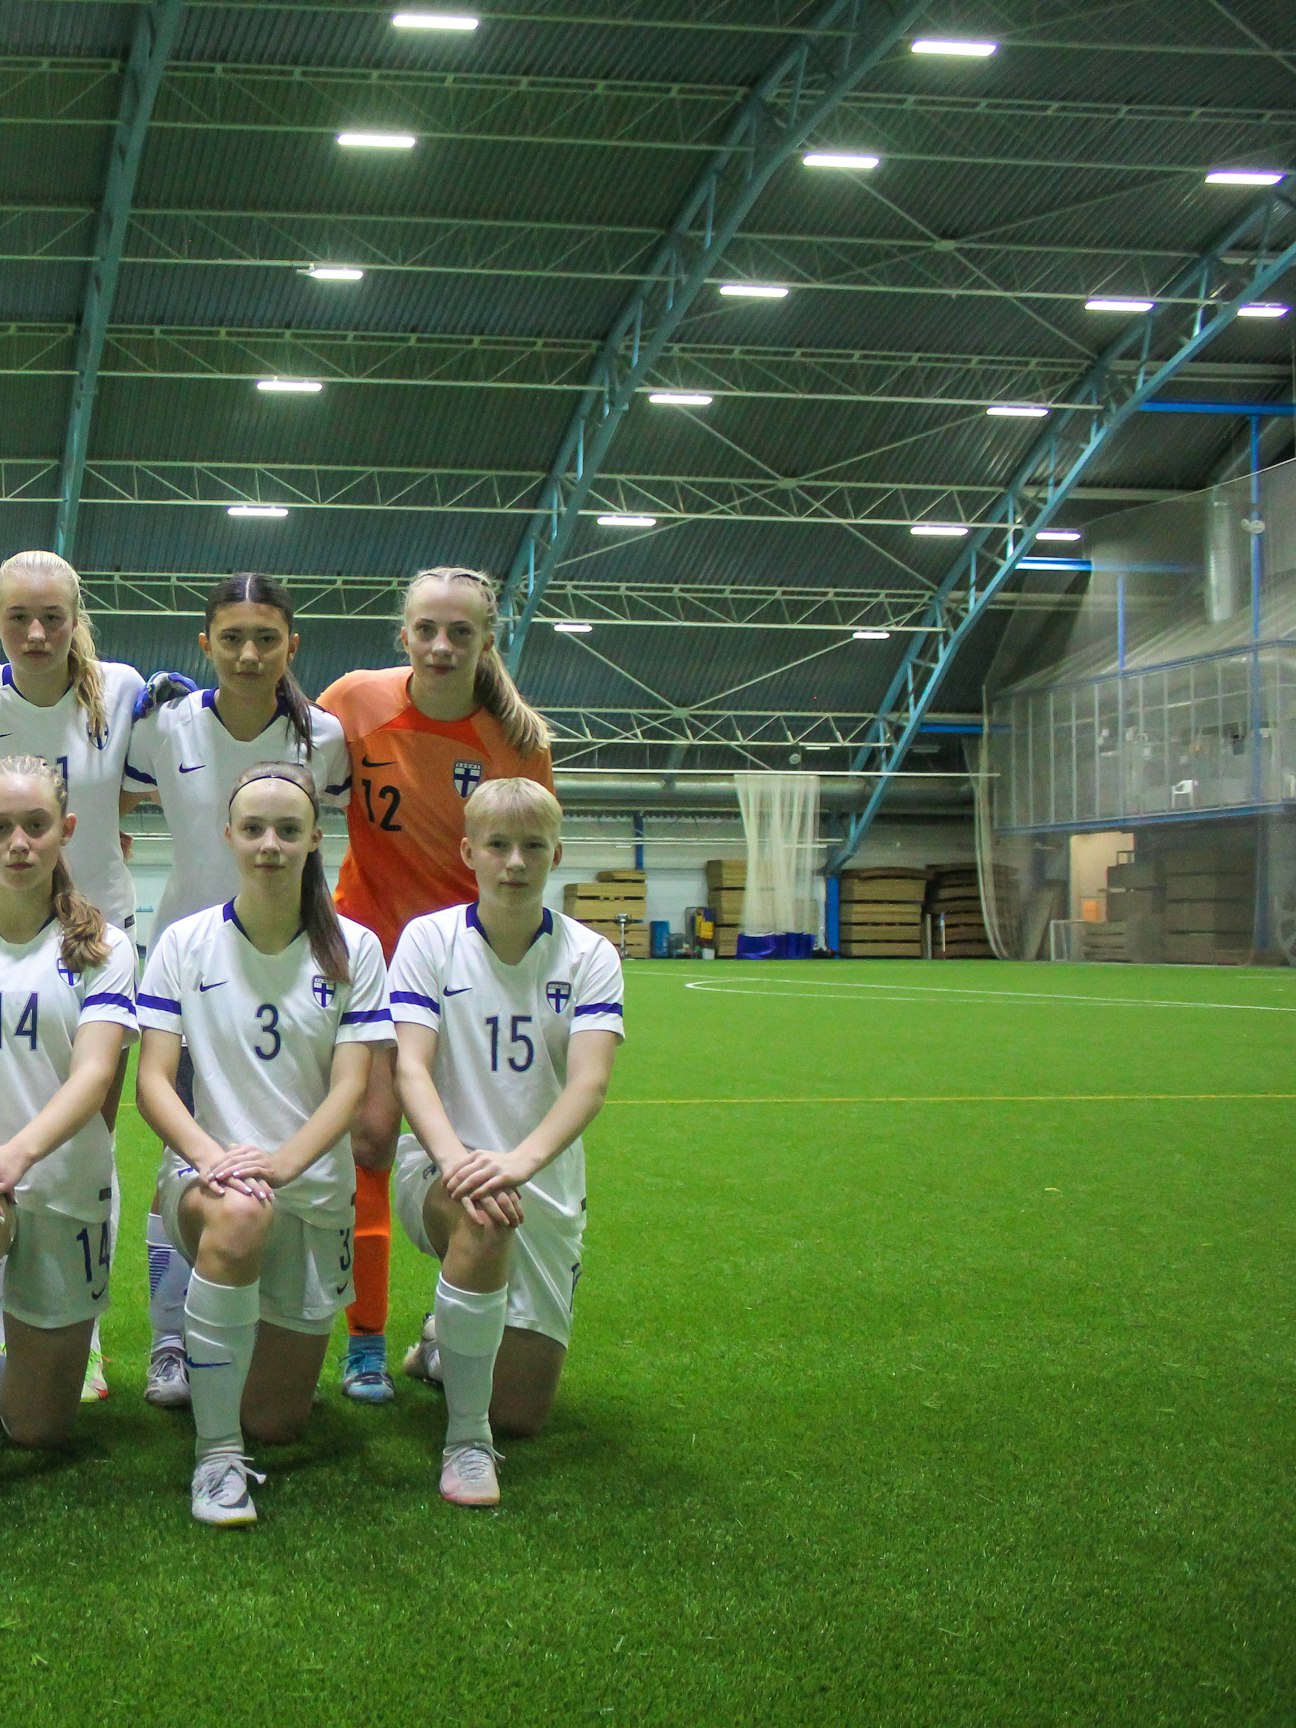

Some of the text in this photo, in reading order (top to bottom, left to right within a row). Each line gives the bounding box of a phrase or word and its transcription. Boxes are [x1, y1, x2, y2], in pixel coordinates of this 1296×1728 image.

[362, 778, 402, 831] 12
[253, 1002, 282, 1061] 3
[485, 1015, 535, 1073] 15
